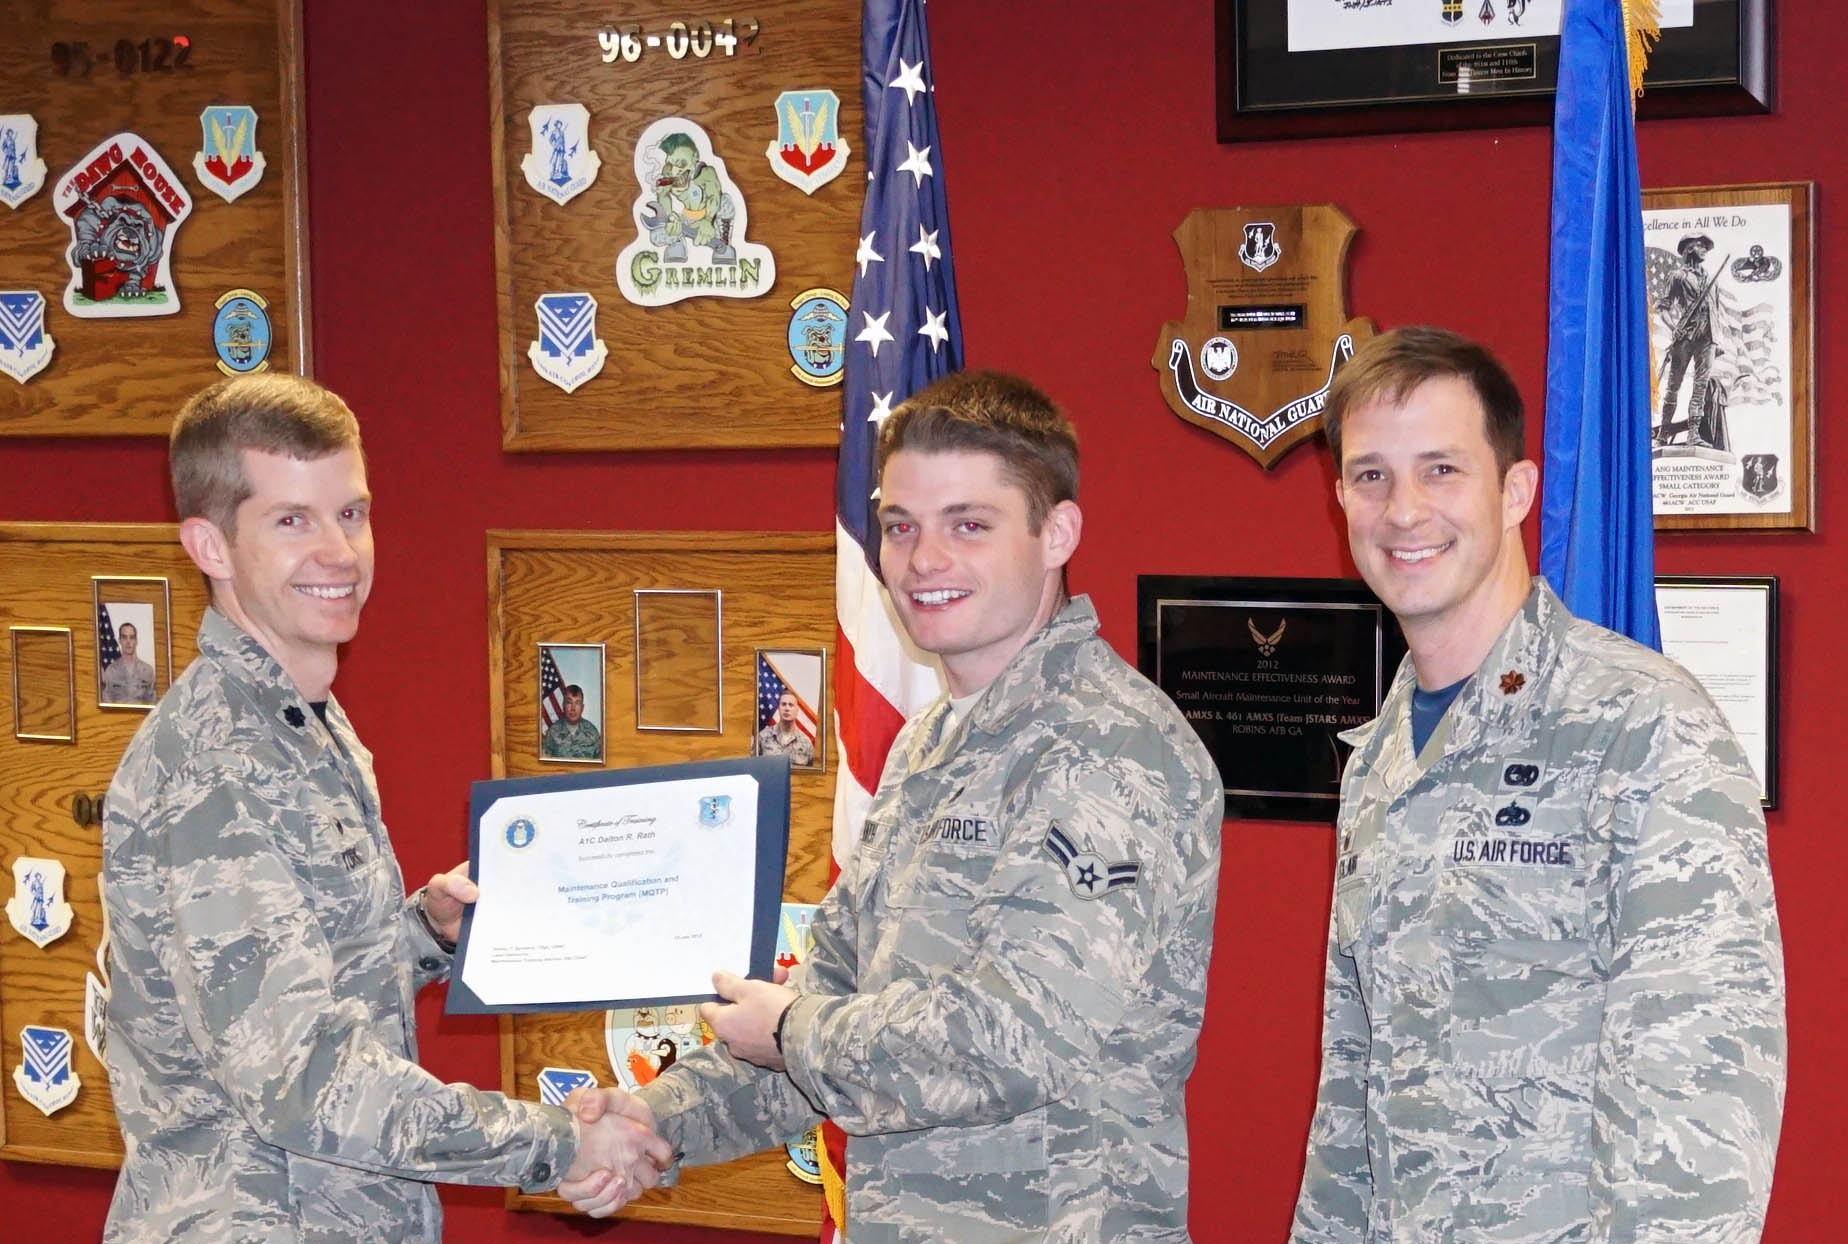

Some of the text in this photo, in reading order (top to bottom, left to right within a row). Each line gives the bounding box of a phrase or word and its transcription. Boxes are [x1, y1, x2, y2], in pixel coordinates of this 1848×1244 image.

[130, 146, 185, 216] HOUSE
[1643, 215, 1747, 231] cellence in All We Do
[1192, 391, 1330, 443] AIR NATIONAL GUAR
[1256, 660, 1280, 670] 2012
[1182, 671, 1356, 685] MAINTENANCE EFFECTIVENESS AWARD
[1176, 690, 1361, 705] Small Aircraft Maintenance Unit of the Year
[1185, 710, 1213, 720] AMXS
[1246, 712, 1274, 722] AMXS
[1276, 712, 1303, 724] (Team
[1232, 724, 1266, 735] ROBINS
[1288, 726, 1303, 736] GA
[1453, 839, 1571, 865] U.S. AIR FORCE
[558, 875, 679, 894] Maintenance Qualification and
[568, 894, 600, 904] Training
[601, 891, 636, 902] Program
